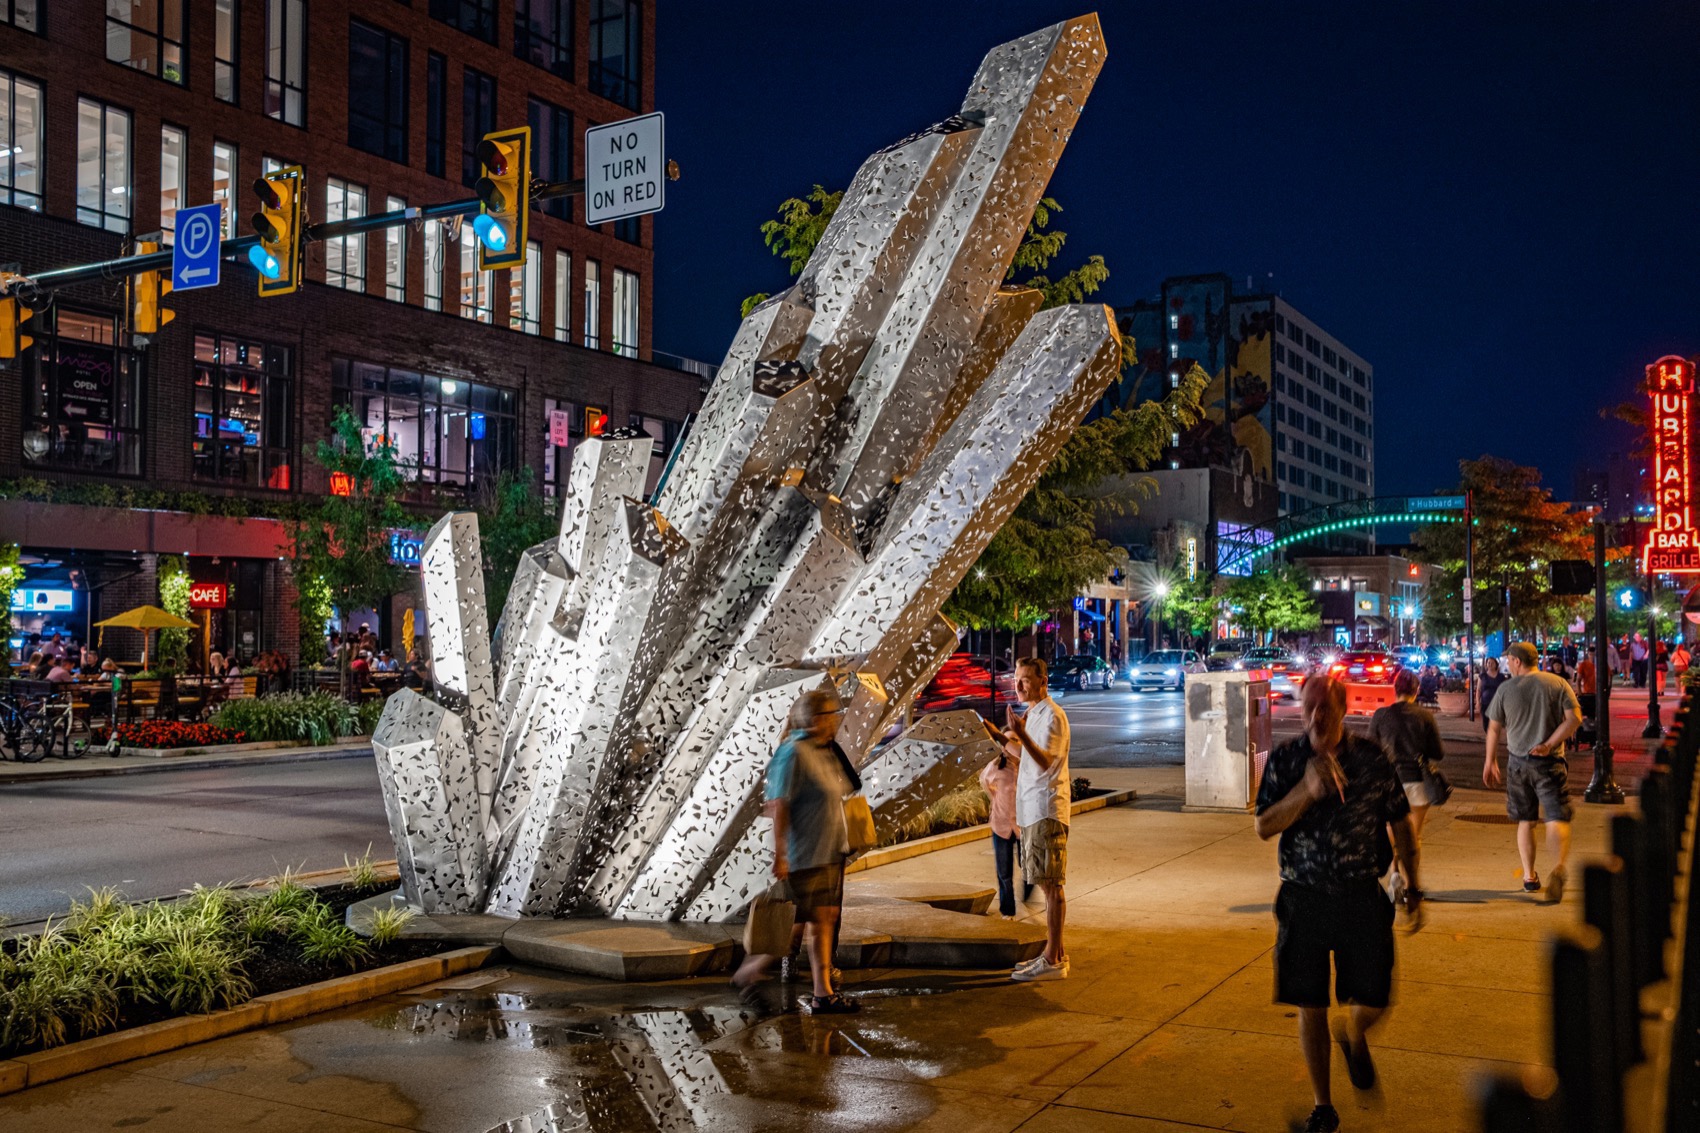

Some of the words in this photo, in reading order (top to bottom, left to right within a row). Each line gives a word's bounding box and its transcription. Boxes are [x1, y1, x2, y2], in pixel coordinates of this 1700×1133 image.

[610, 132, 638, 155] NO
[602, 156, 646, 182] TURN
[593, 189, 615, 210] ON
[623, 181, 656, 204] RED
[190, 222, 206, 250] P
[73, 380, 97, 391] OPEN
[1660, 364, 1682, 531] HUBBARD
[1417, 499, 1452, 508] Hubbard
[1658, 533, 1689, 548] BAR
[1650, 554, 1699, 568] GRILLE
[192, 586, 220, 602] CAFÉ
